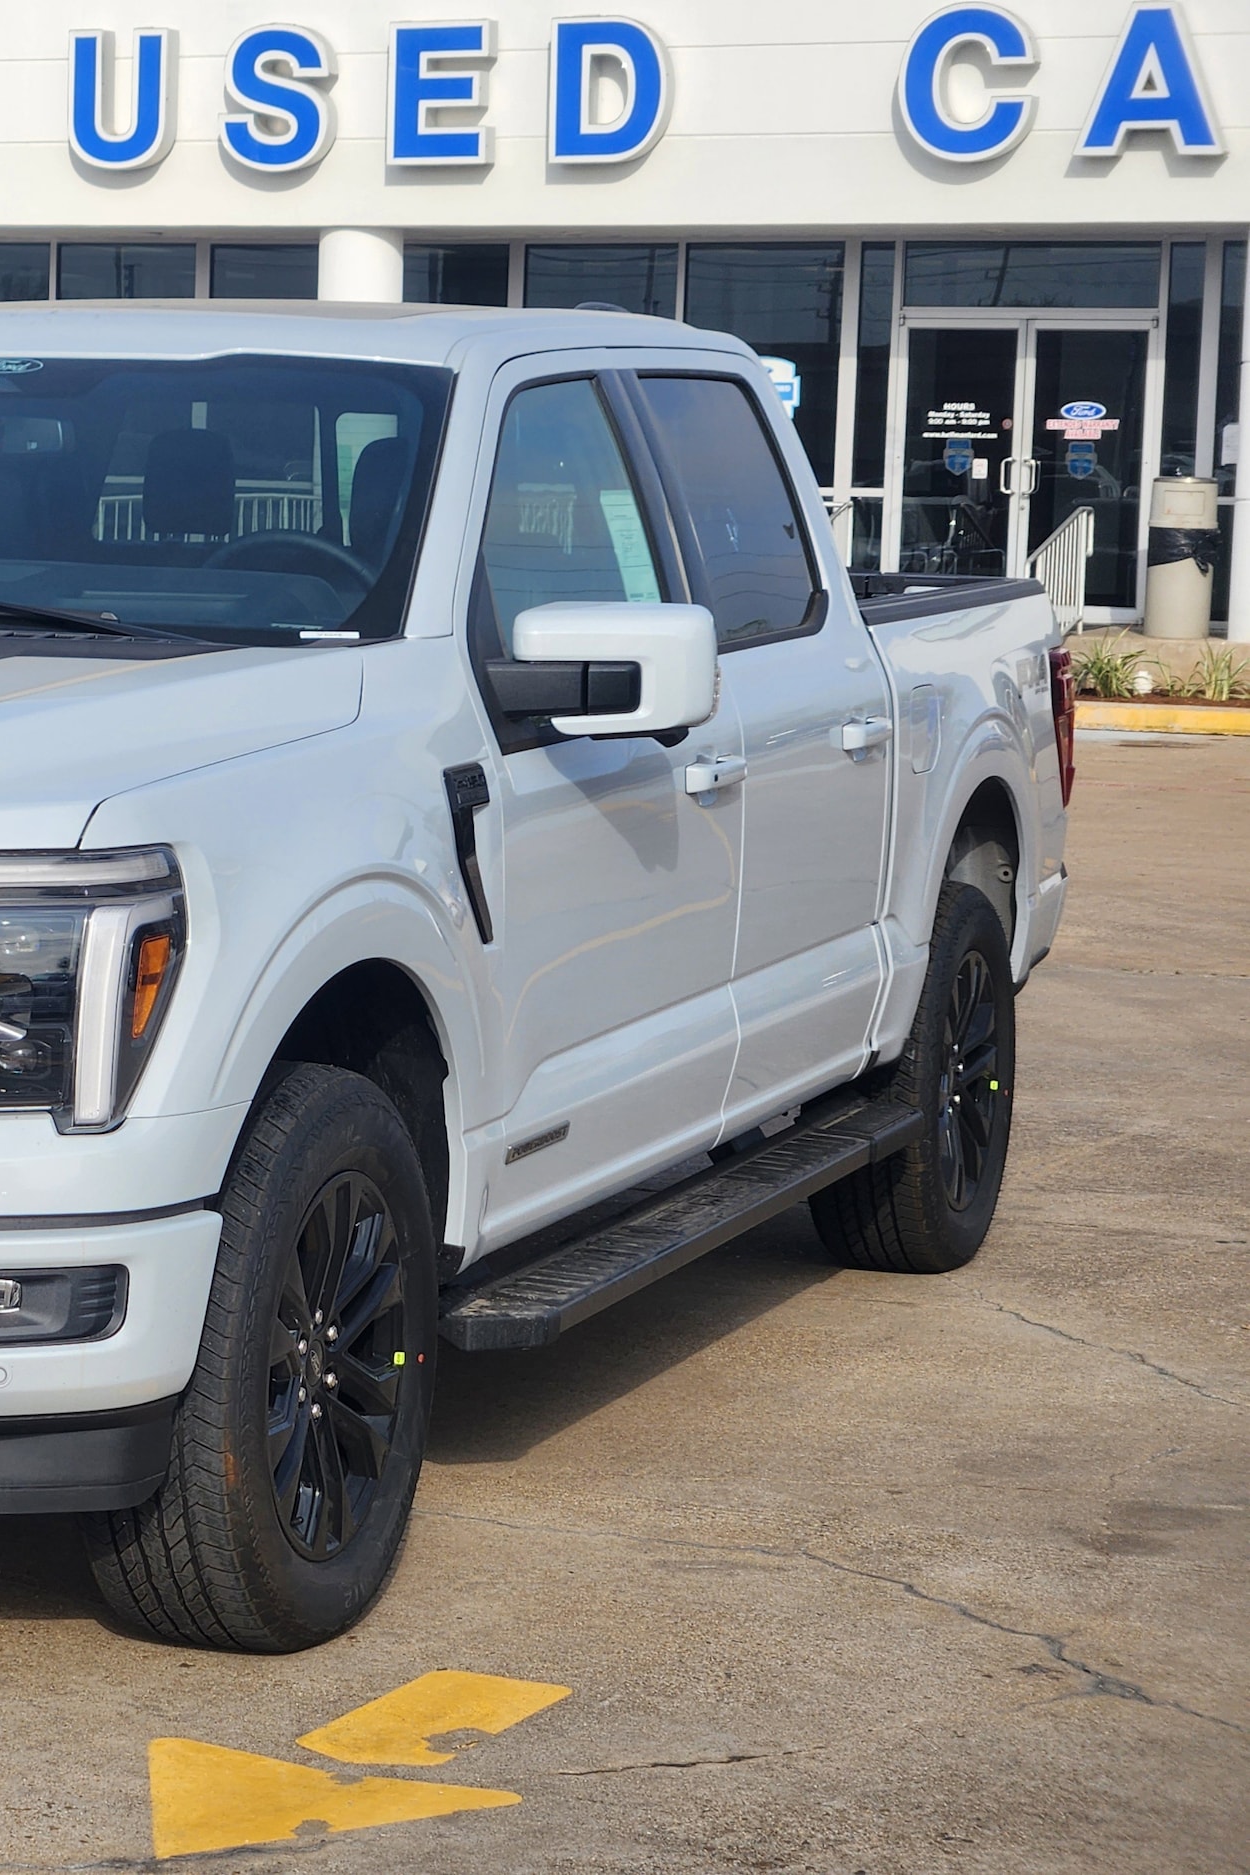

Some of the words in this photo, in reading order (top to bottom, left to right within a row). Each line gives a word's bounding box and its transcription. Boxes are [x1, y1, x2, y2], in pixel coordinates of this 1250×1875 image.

[68, 16, 674, 172] USED
[943, 402, 976, 411] HOURS
[1070, 405, 1097, 416] Ford
